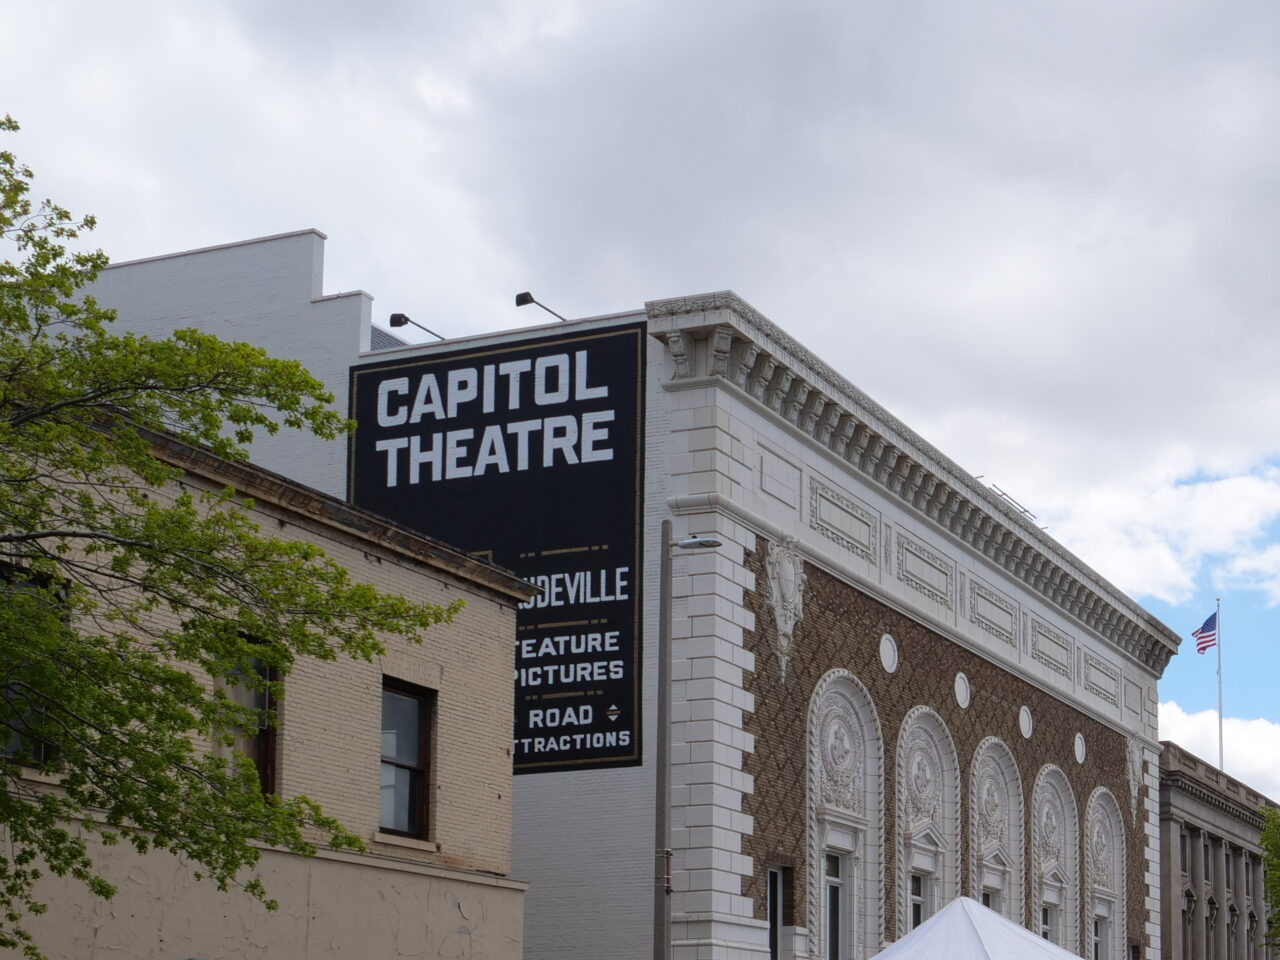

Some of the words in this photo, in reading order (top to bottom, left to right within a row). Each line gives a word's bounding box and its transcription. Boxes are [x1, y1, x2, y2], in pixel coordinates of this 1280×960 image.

[377, 350, 609, 428] CAPITOL
[375, 409, 615, 487] THEATRE
[517, 567, 630, 610] UDEVILLE
[514, 631, 620, 659] EATURE
[529, 705, 593, 729] ROAD
